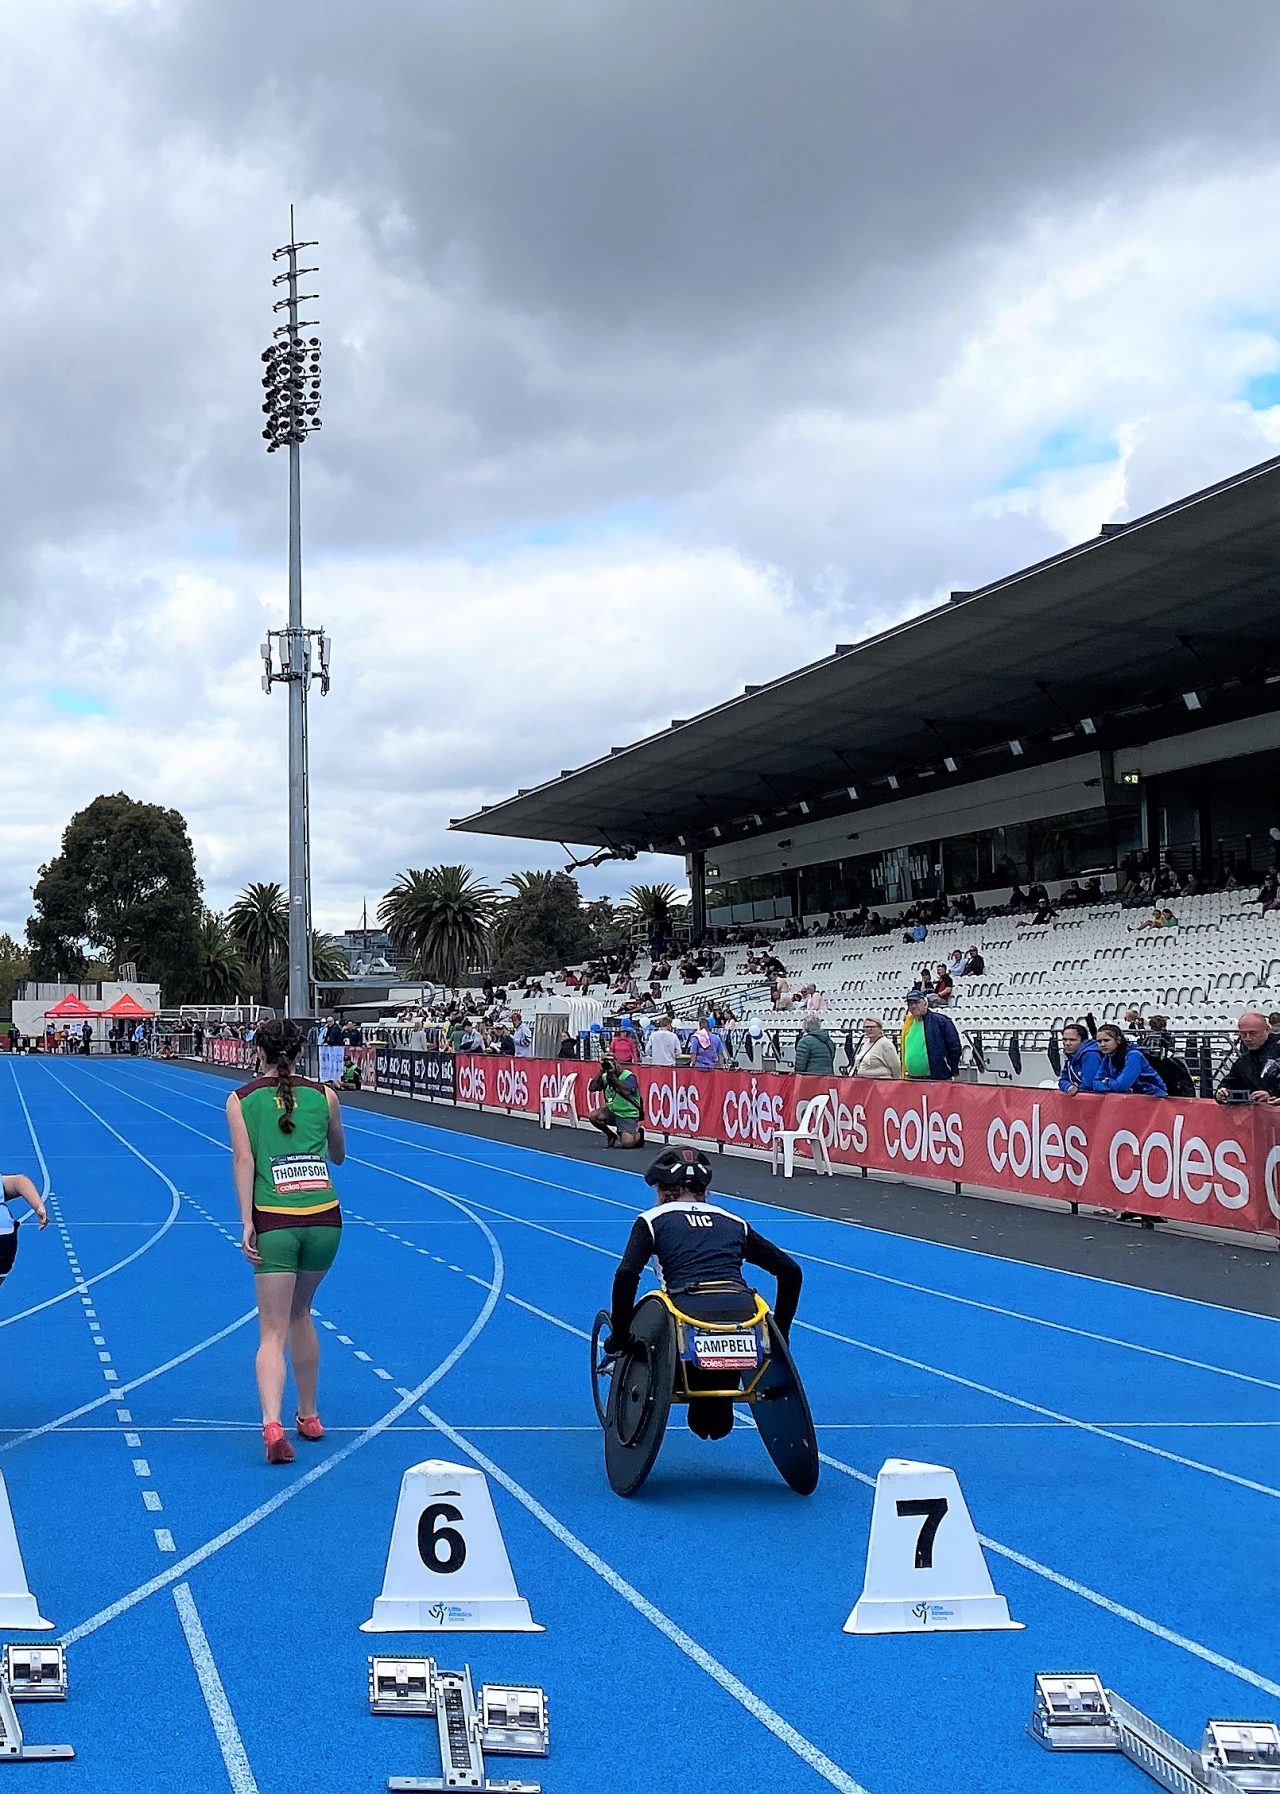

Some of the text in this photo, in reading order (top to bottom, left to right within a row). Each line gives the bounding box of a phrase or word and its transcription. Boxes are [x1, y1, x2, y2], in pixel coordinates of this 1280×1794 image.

[459, 1058, 486, 1100] coles
[496, 1060, 528, 1106] coles
[649, 1071, 701, 1133] coles
[722, 1077, 784, 1144] coles
[883, 1095, 965, 1168] coles
[987, 1104, 1089, 1187] coles
[1109, 1115, 1250, 1210] coles
[274, 1166, 326, 1180] THOMPSON
[280, 1183, 300, 1192] coles
[684, 1214, 713, 1227] VIC
[695, 1340, 757, 1353] CAMPBELL
[700, 1359, 723, 1367] coles
[418, 1503, 466, 1574] 6
[896, 1498, 948, 1569] 7
